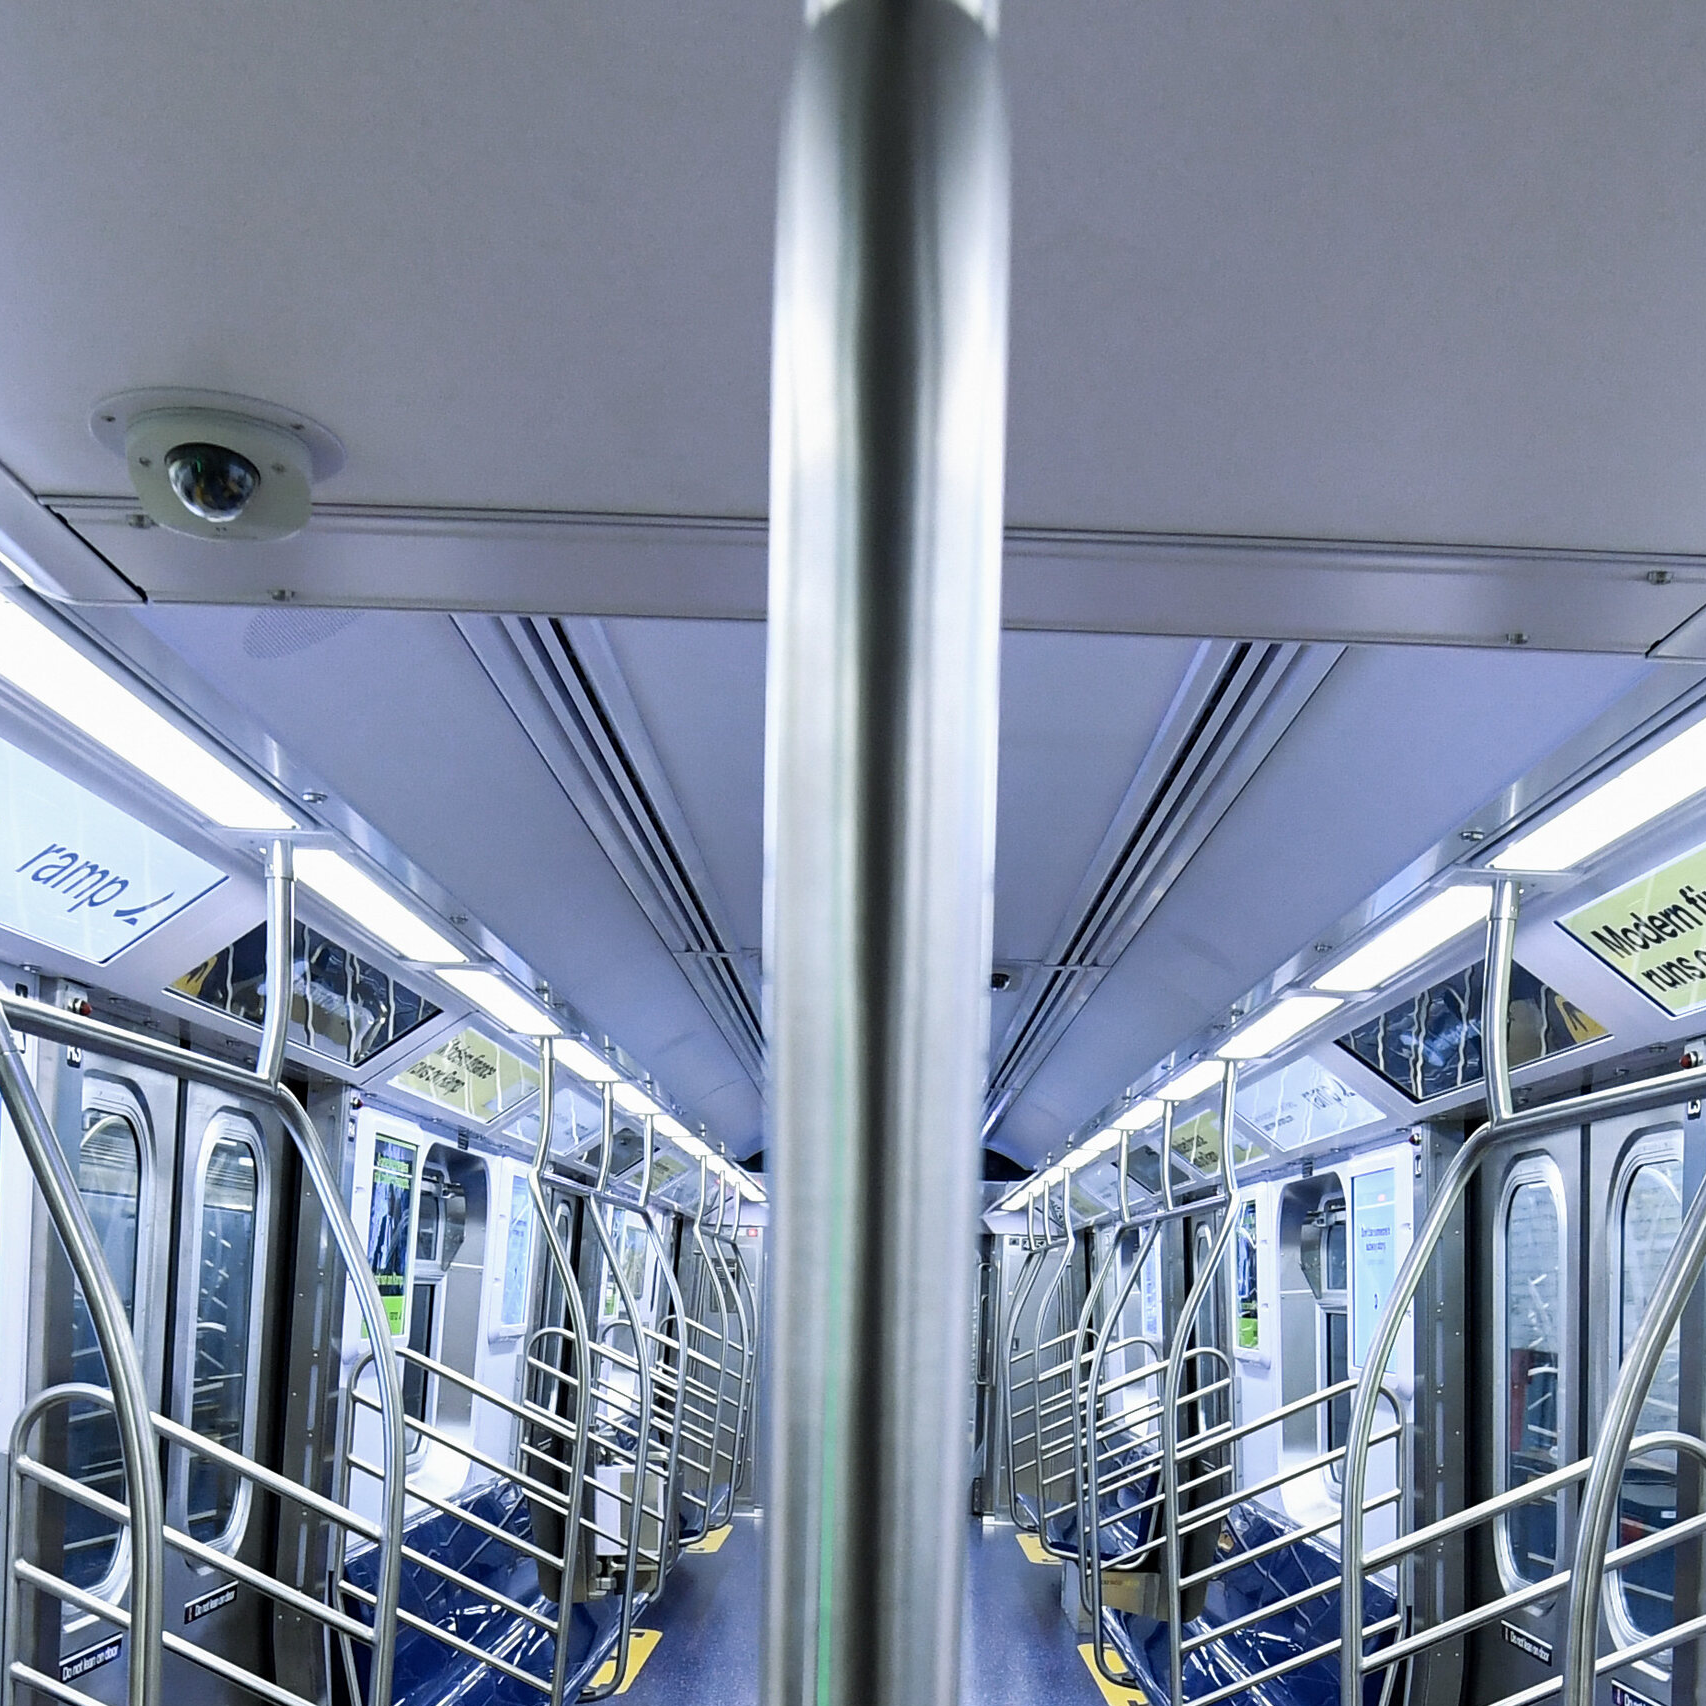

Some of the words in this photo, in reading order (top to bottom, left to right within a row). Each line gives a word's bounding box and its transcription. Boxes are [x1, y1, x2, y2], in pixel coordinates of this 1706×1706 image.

[15, 843, 130, 913] ramp
[1590, 903, 1704, 959] Modern
[62, 1664, 73, 1682] Do
[73, 1659, 83, 1676] not
[83, 1654, 96, 1671] lean
[96, 1651, 105, 1666] on
[105, 1645, 119, 1662] door
